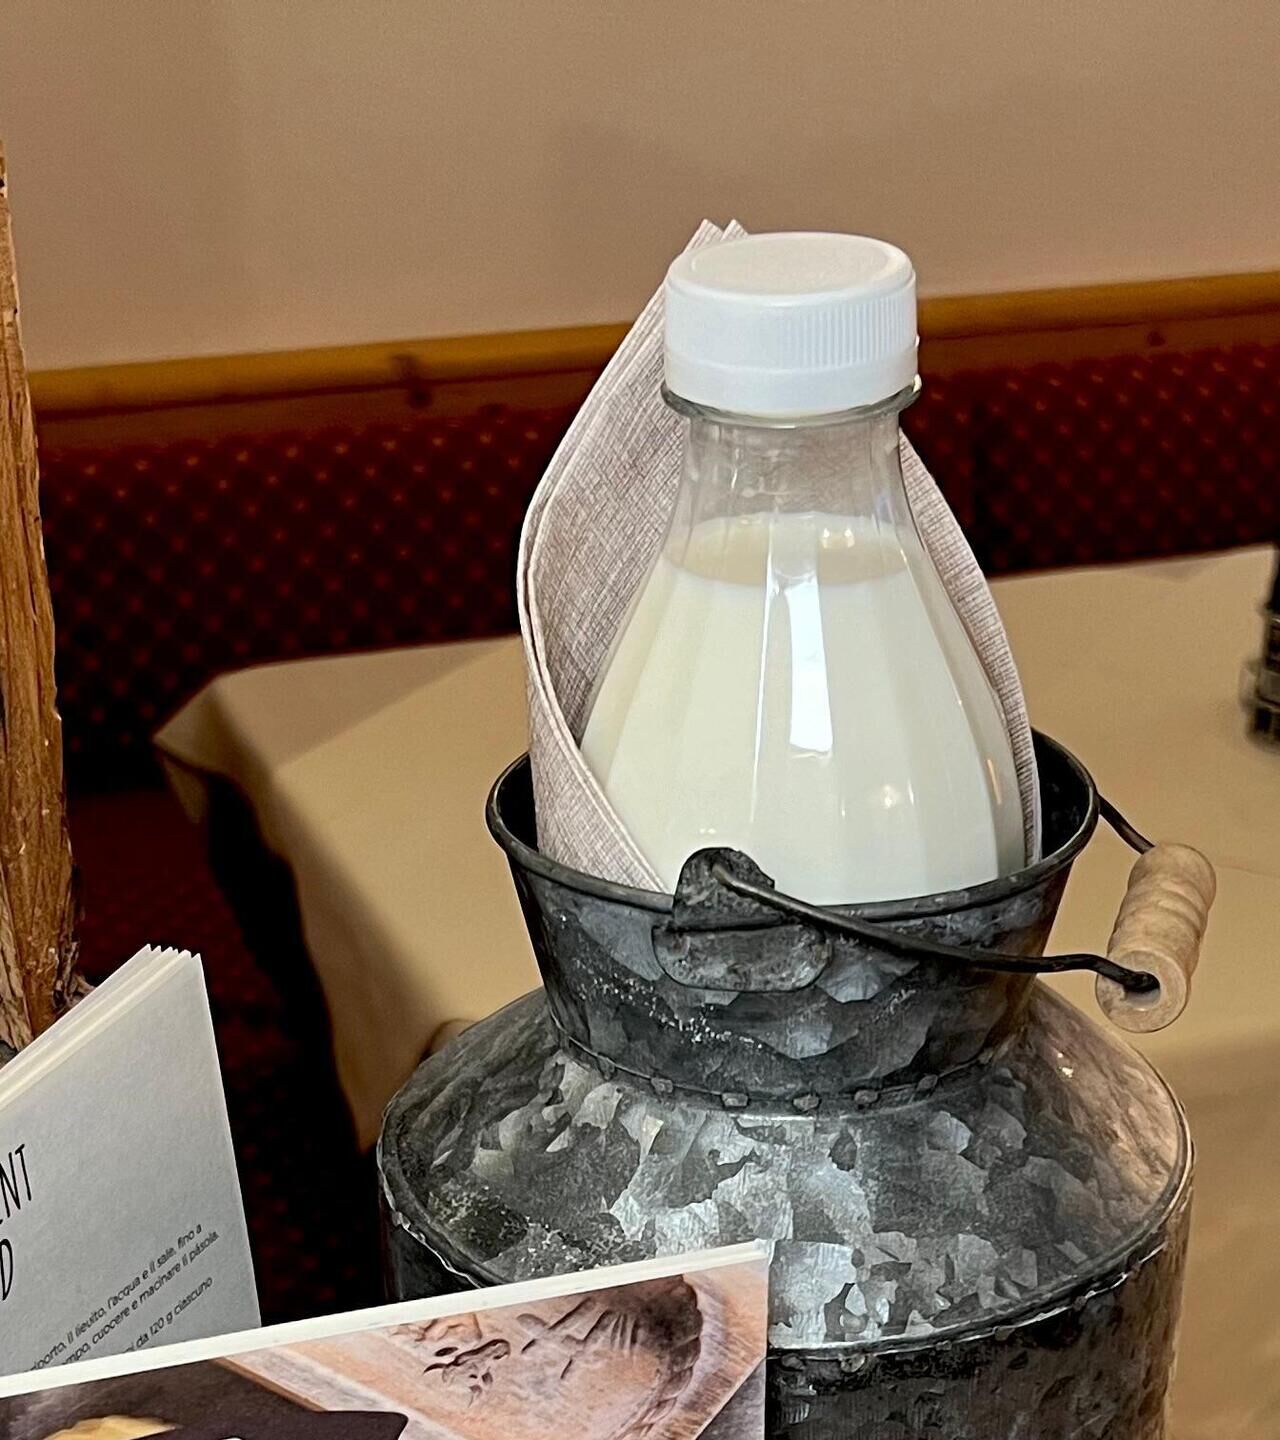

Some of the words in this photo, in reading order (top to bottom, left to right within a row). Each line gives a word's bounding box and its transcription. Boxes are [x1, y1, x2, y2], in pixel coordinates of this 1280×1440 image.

[142, 1270, 149, 1280] e
[178, 1230, 195, 1249] fino
[196, 1224, 202, 1234] a
[92, 1307, 130, 1345] cuocere
[132, 1300, 138, 1310] e
[140, 1263, 181, 1304] macinare
[136, 1333, 150, 1348] da
[149, 1317, 164, 1336] 120
[166, 1311, 173, 1324] g
[174, 1277, 213, 1316] ciascuno
